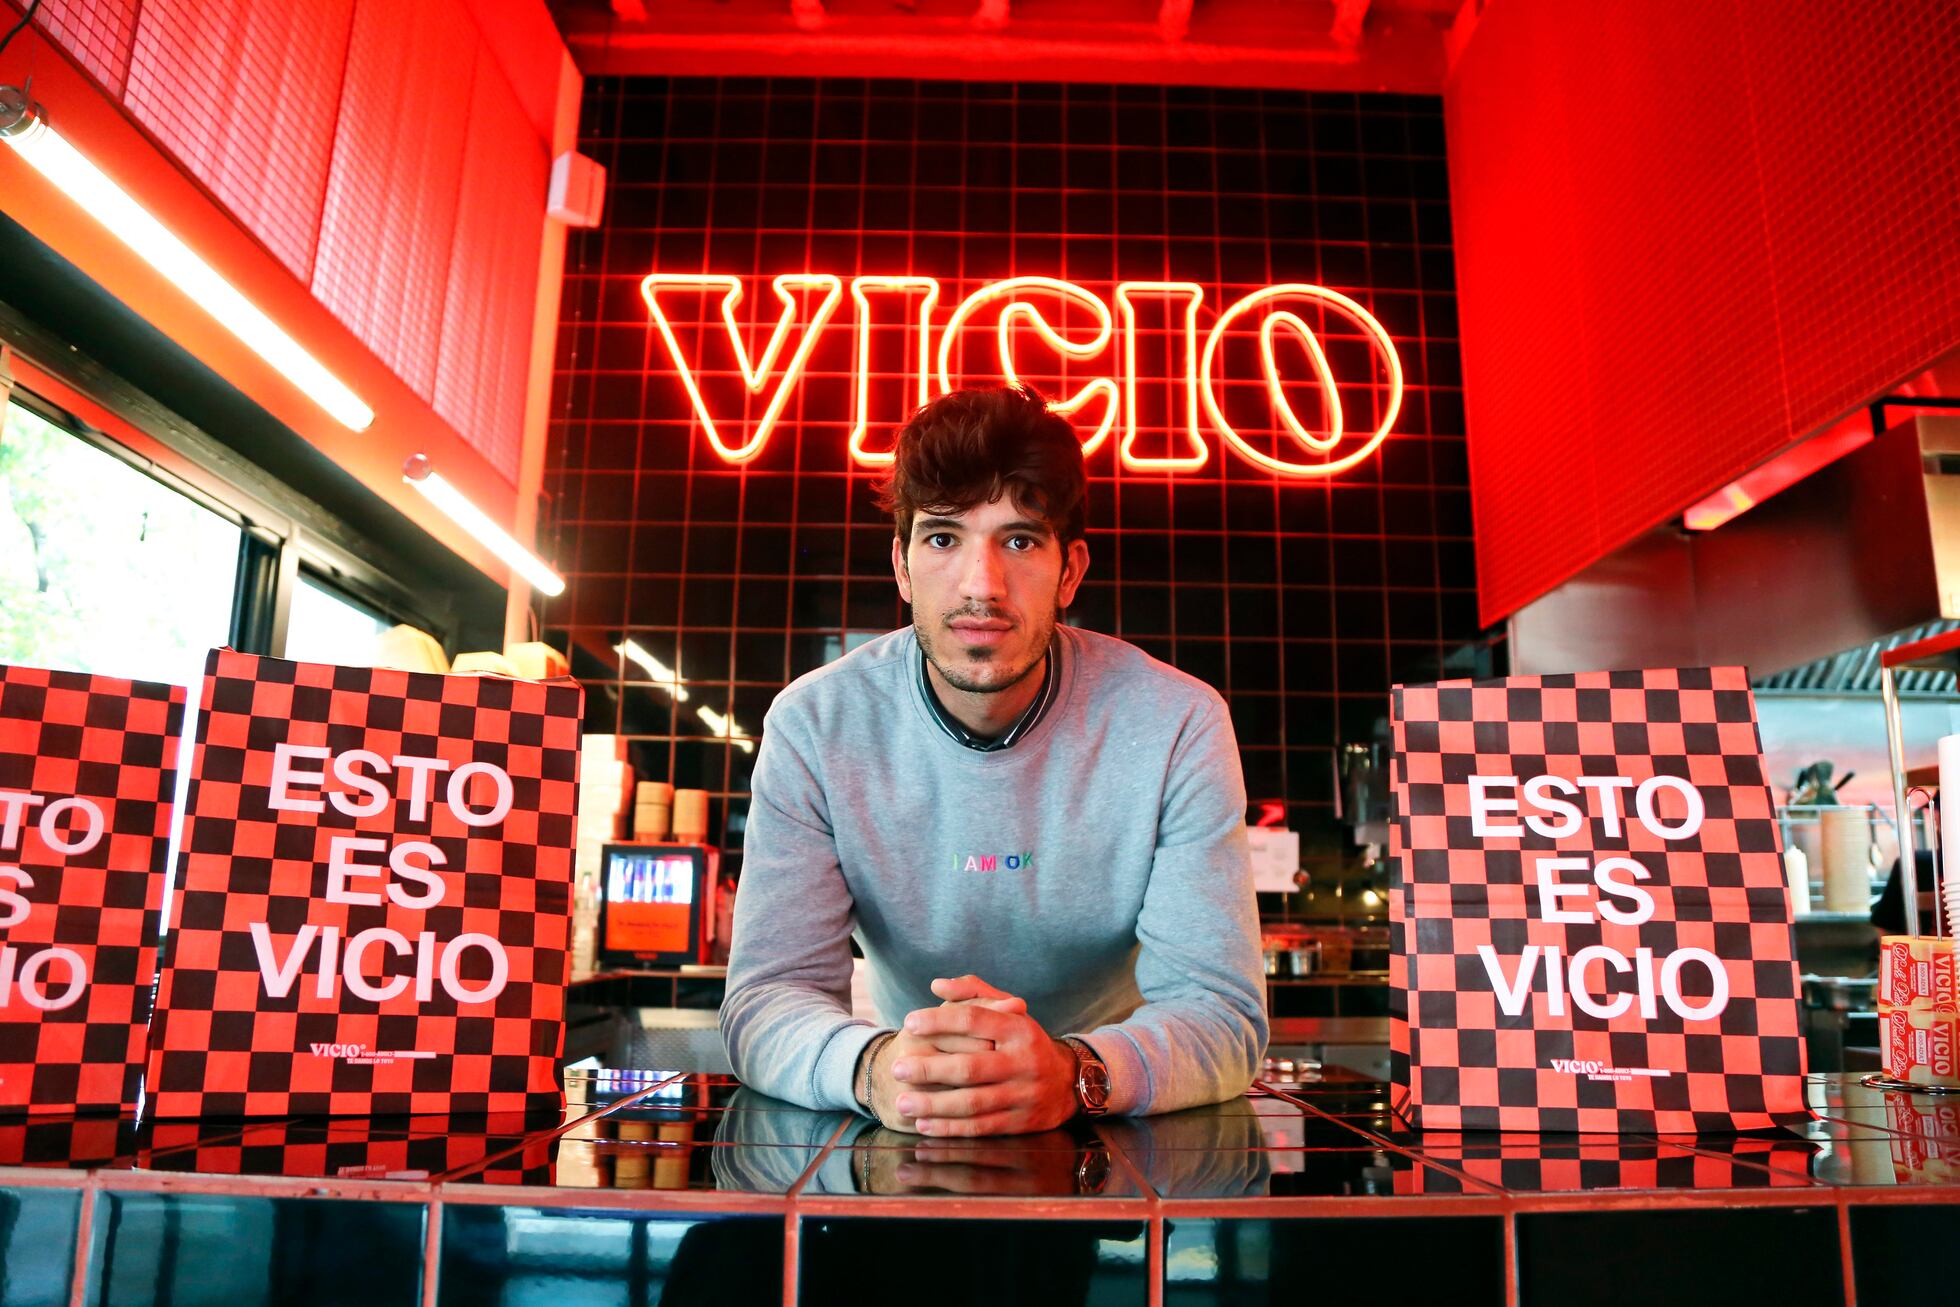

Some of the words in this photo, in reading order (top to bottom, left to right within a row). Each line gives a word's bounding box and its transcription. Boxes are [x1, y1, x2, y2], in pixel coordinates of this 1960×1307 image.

[640, 272, 1404, 477] VICIO
[268, 743, 514, 827] ESTO
[1468, 775, 1705, 840] ESTO
[326, 836, 447, 909] ES
[952, 854, 958, 870] I
[964, 855, 996, 872] AM
[1005, 852, 1032, 870] OK
[1535, 857, 1655, 925] ES
[249, 922, 509, 1004] VICIO
[1476, 945, 1729, 1020] VICIO
[1936, 955, 1952, 1004] VICIO
[1934, 1023, 1950, 1075] VICIO
